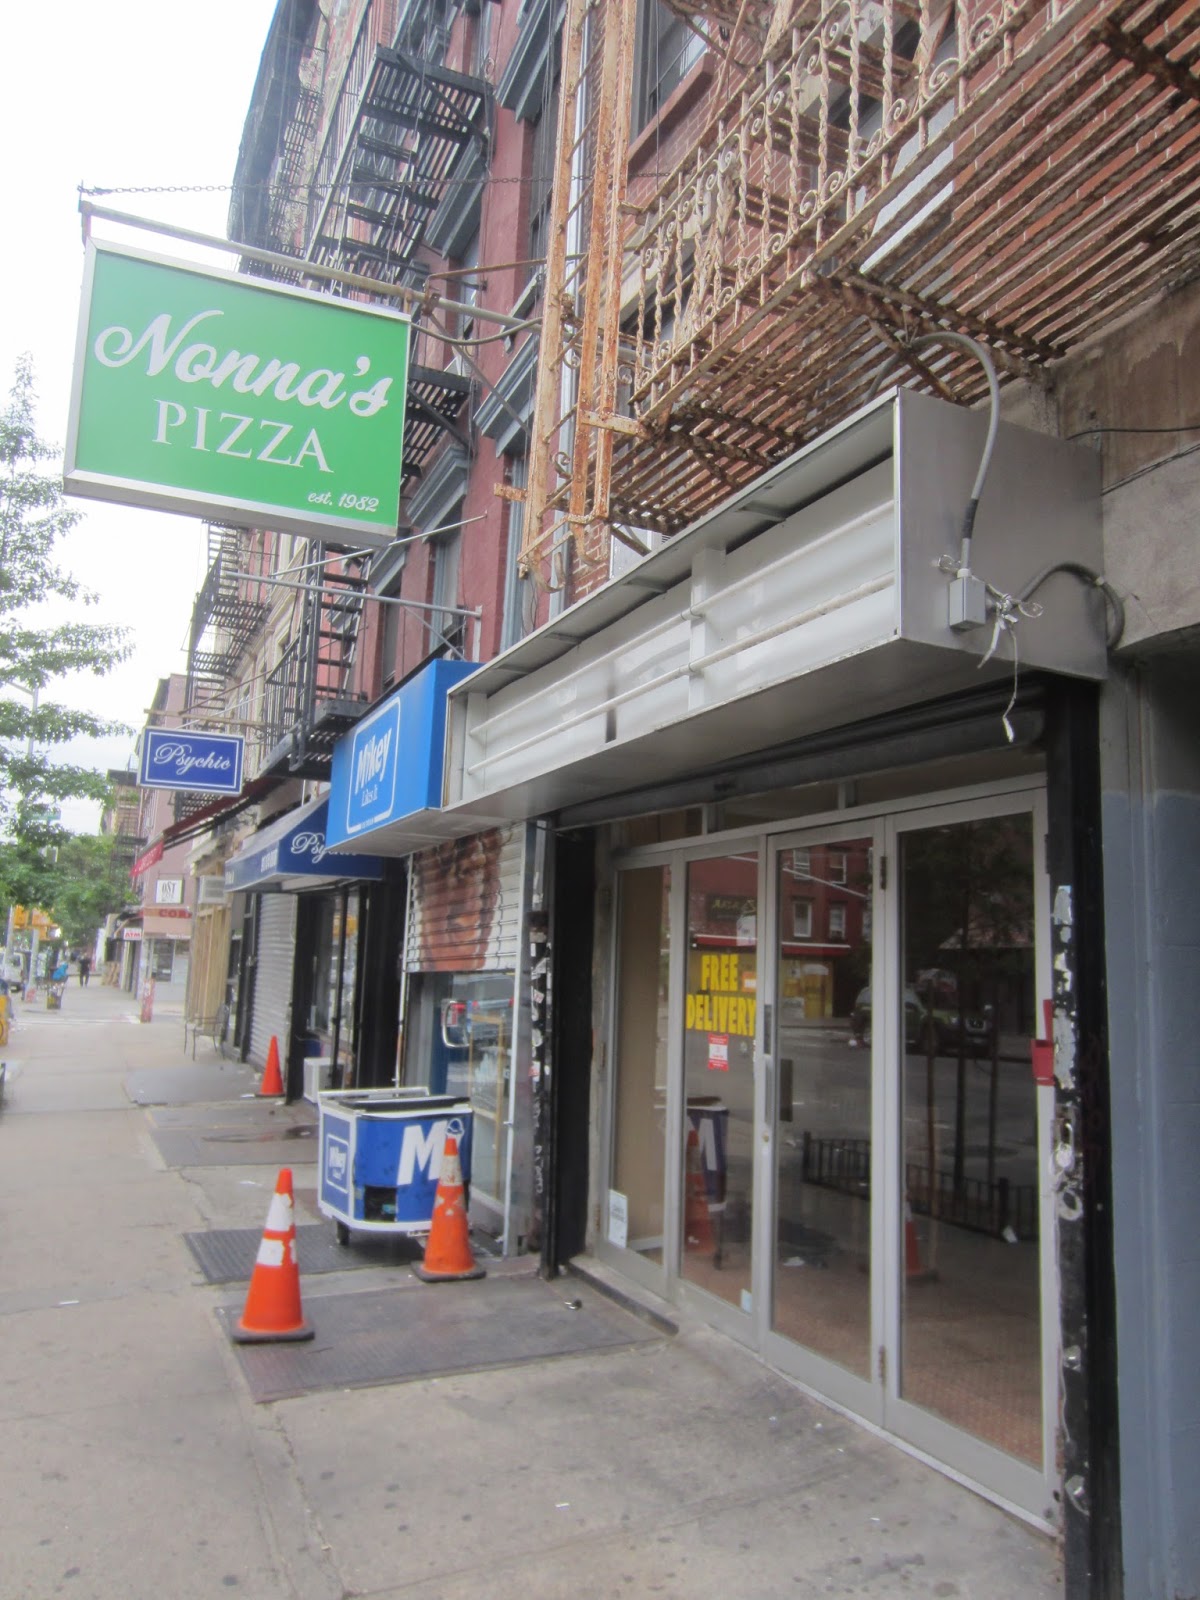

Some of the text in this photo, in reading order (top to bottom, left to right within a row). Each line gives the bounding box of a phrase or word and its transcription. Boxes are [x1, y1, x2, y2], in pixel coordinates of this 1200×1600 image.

[94, 309, 394, 418] Nonna's
[152, 399, 334, 473] PIZZA
[308, 491, 379, 512] est. 1982
[153, 742, 232, 776] Psychic
[701, 954, 739, 992] FREE
[686, 993, 757, 1037] DELIVERY
